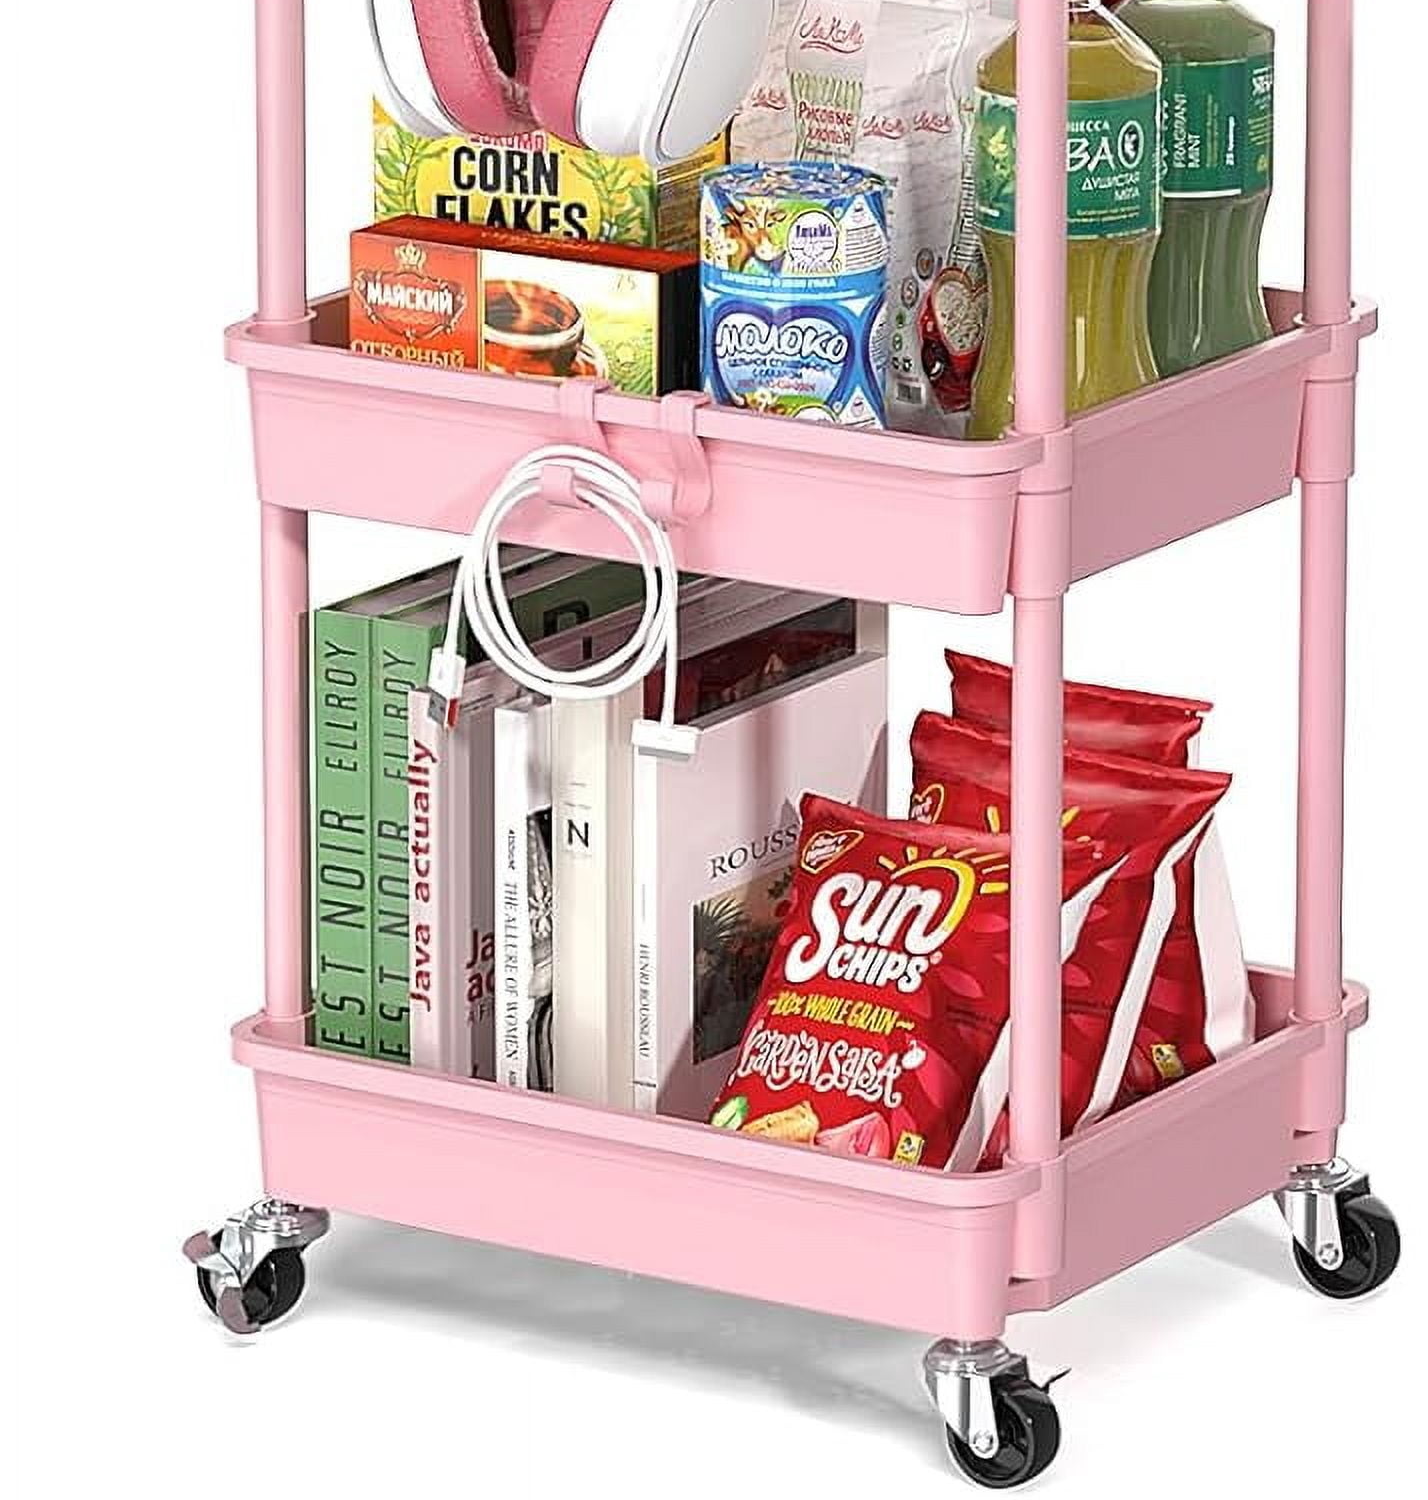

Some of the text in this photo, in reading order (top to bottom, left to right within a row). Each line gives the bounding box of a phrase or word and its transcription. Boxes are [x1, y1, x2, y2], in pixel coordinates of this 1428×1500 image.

[453, 145, 559, 197] CORN
[1187, 133, 1201, 169] MINT
[716, 322, 849, 365] МОЛОКО
[319, 640, 367, 1050] EST NOIR ELLROY
[567, 818, 589, 848] N
[709, 823, 798, 880] ROUSS
[407, 738, 439, 1013] Java actually
[827, 942, 929, 994] CHIPS
[802, 992, 852, 1024] WHOLE
[847, 998, 899, 1036] GRAIN
